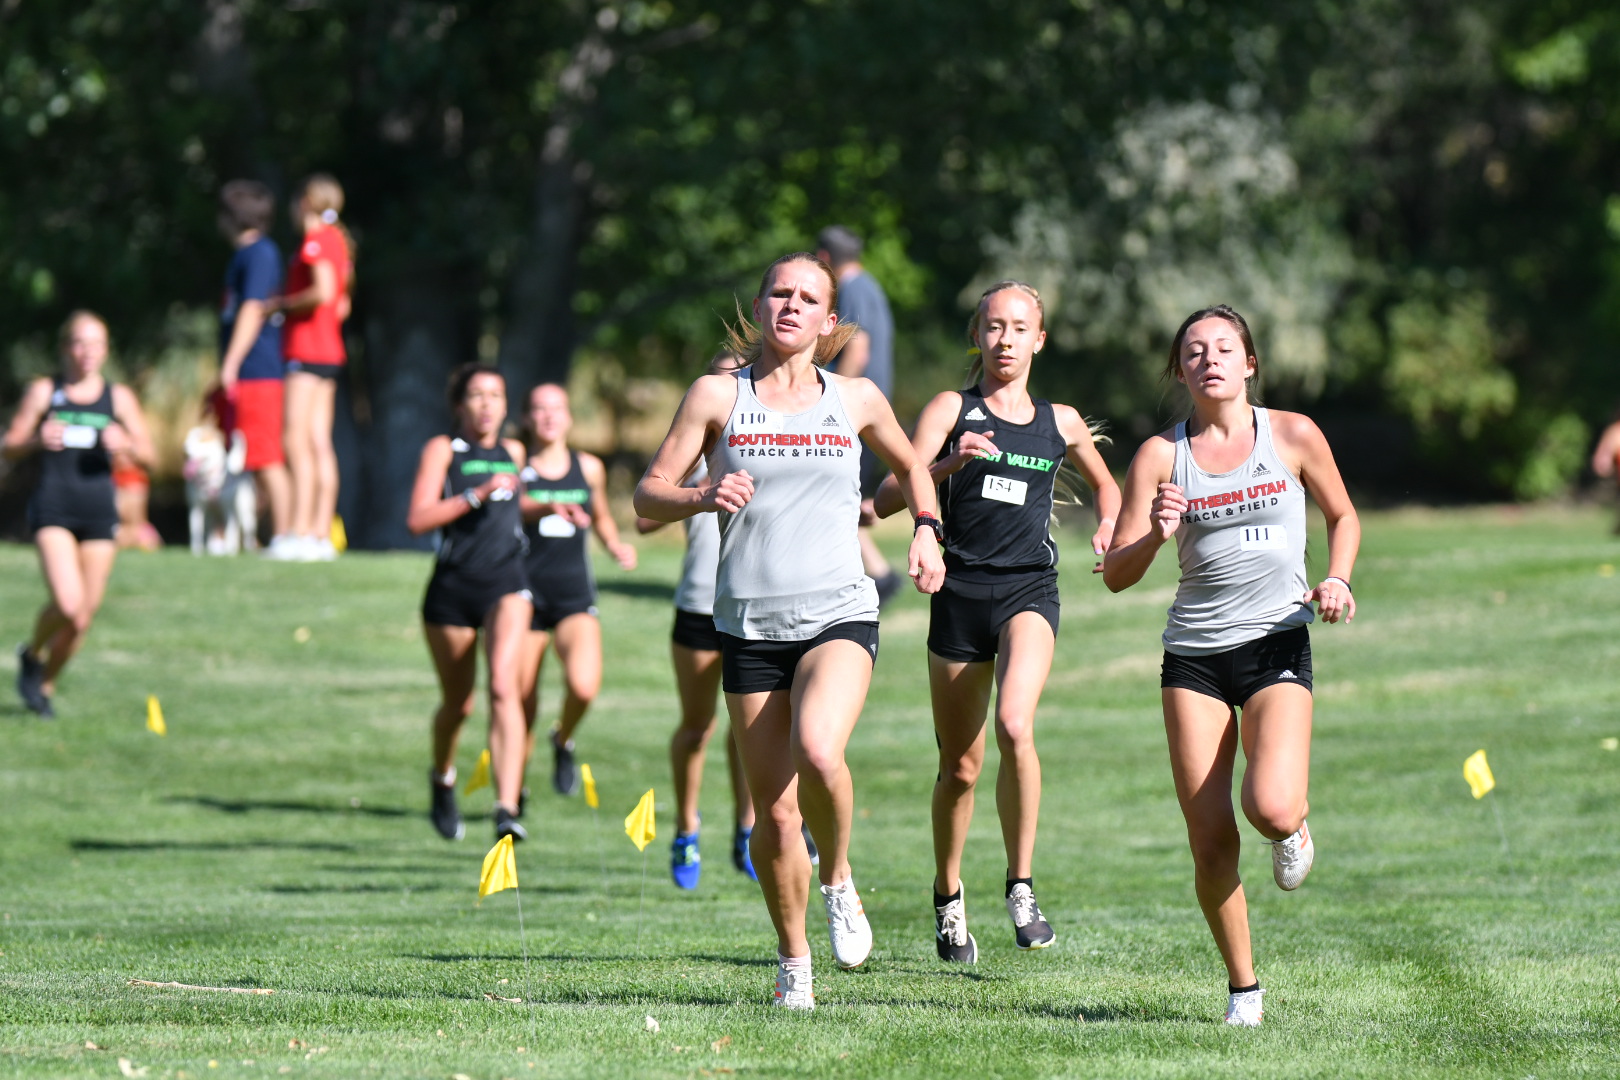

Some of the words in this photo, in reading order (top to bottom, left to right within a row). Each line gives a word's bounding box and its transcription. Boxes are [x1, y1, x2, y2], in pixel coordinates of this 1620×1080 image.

[740, 412, 766, 425] 110
[728, 434, 812, 448] SOUTHERN
[815, 434, 853, 449] UTAH
[739, 448, 786, 457] TRACK
[791, 449, 800, 457] &
[806, 449, 844, 457] FIELD
[1006, 452, 1054, 472] VALLEY
[989, 477, 1012, 493] 154
[1247, 480, 1288, 499] UTAH
[1180, 509, 1220, 525] TRACK
[1226, 508, 1234, 516] &
[1244, 527, 1269, 542] 111
